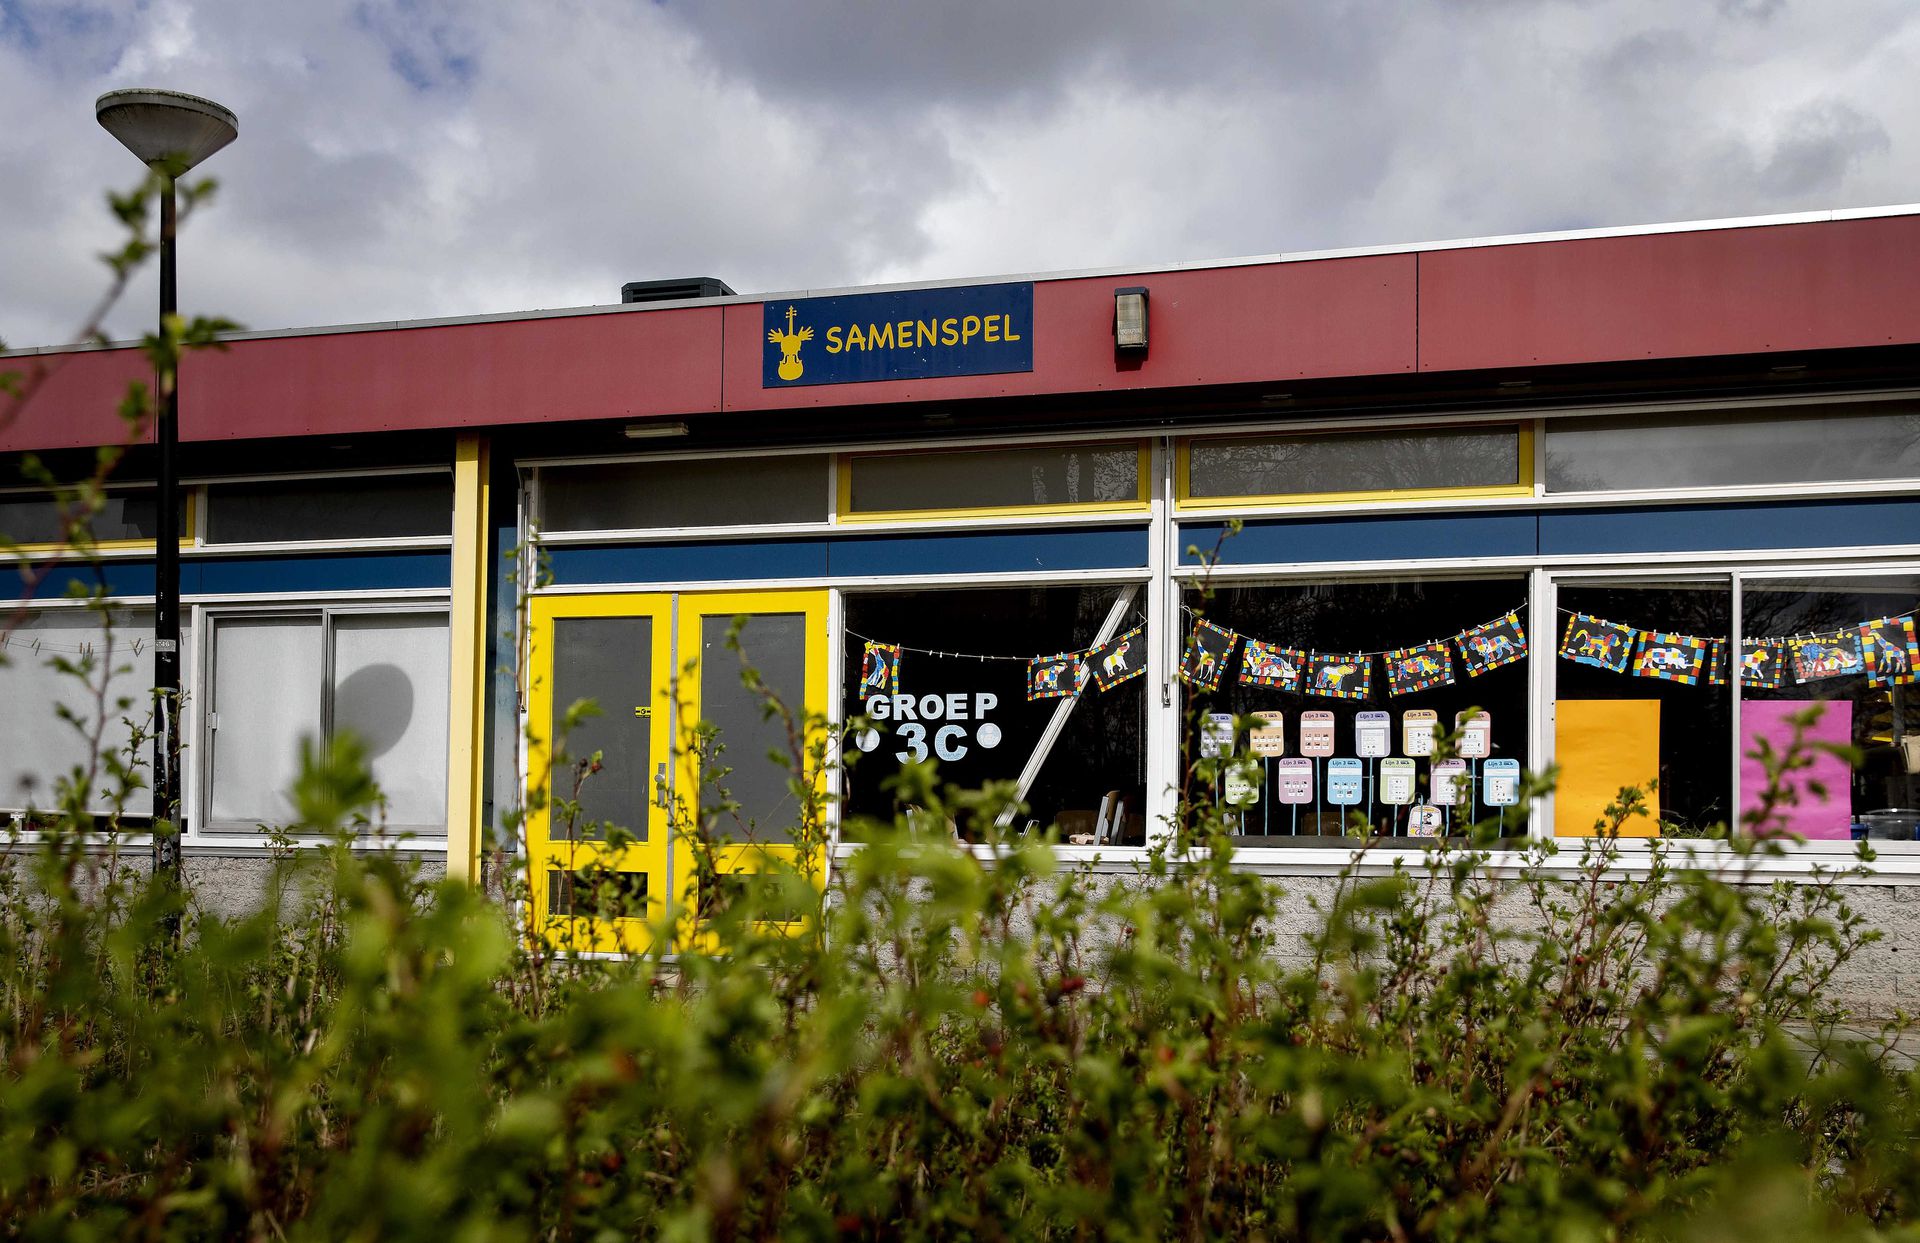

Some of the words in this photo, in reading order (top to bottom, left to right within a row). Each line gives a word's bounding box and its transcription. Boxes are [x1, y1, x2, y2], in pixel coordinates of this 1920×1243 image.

[826, 314, 1020, 354] SAMENSPEL
[866, 693, 998, 720] GROEP
[895, 722, 968, 765] 3C
